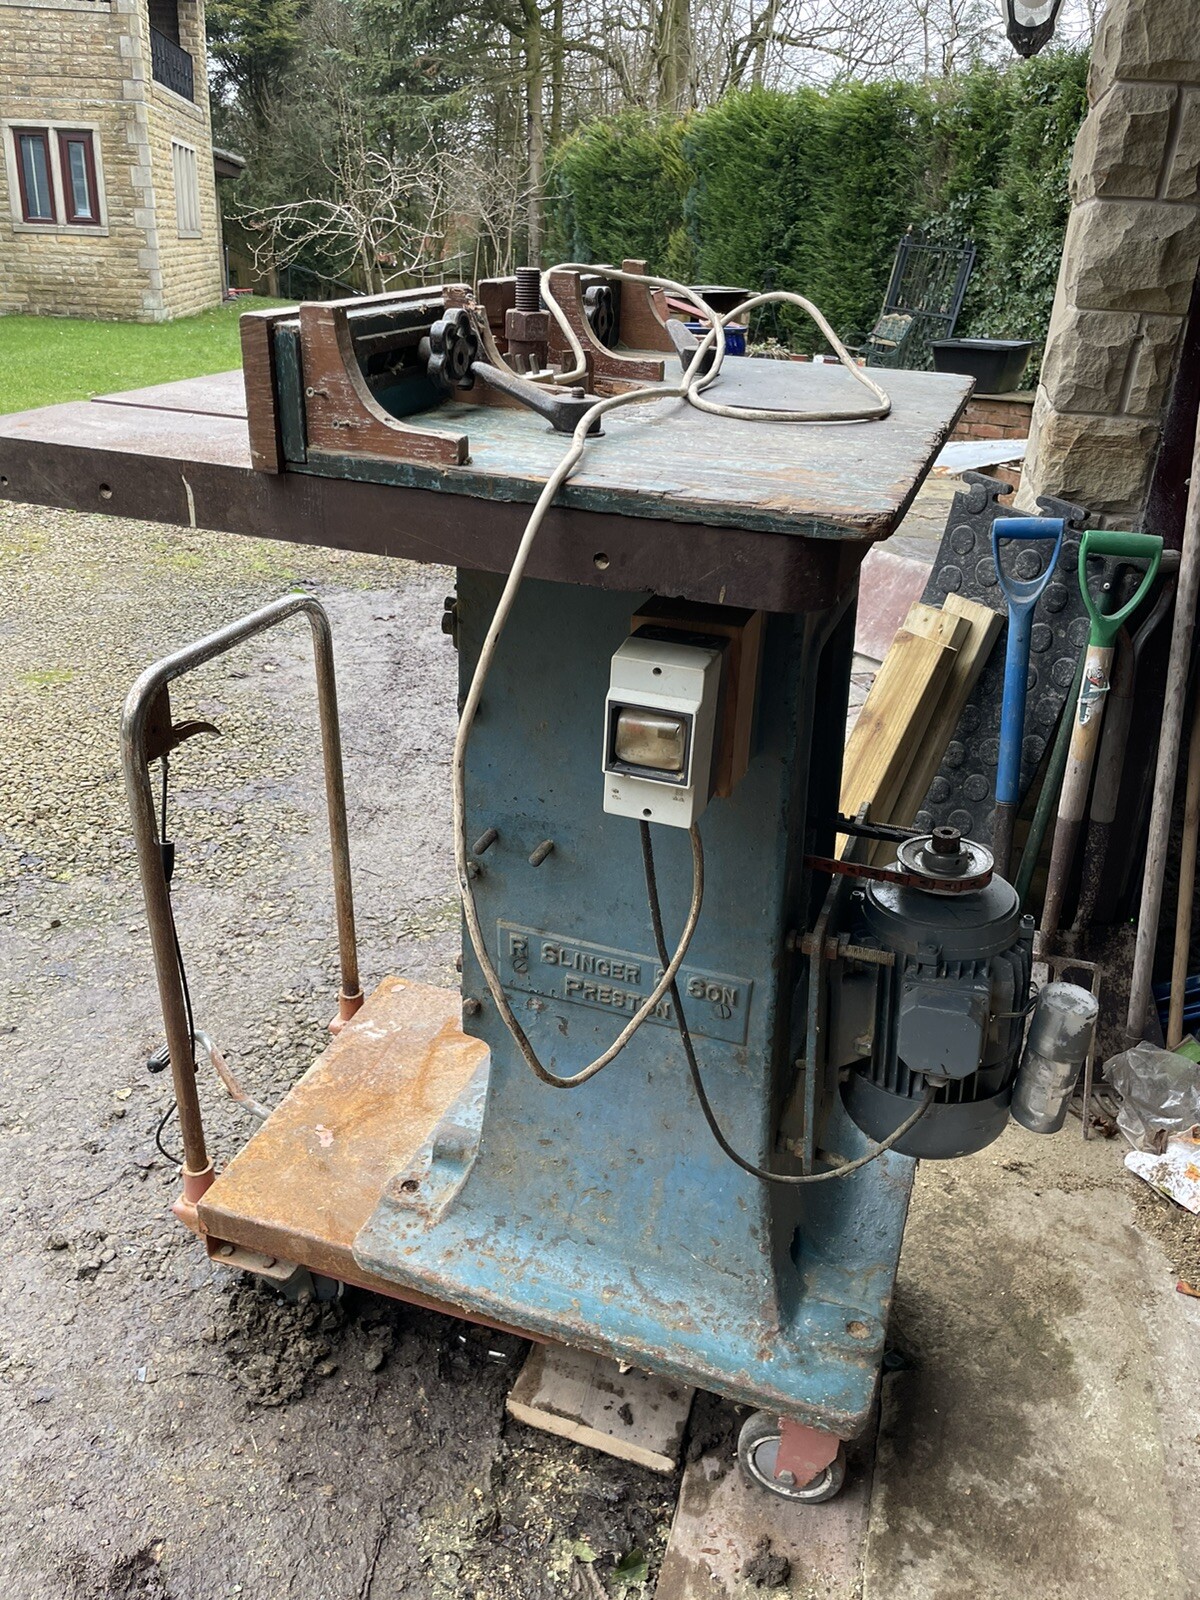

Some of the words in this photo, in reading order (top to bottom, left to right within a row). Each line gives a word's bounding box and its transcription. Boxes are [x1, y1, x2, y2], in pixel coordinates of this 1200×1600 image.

[509, 932, 528, 957] R
[541, 940, 641, 984] SLINGER
[687, 976, 738, 1006] SON
